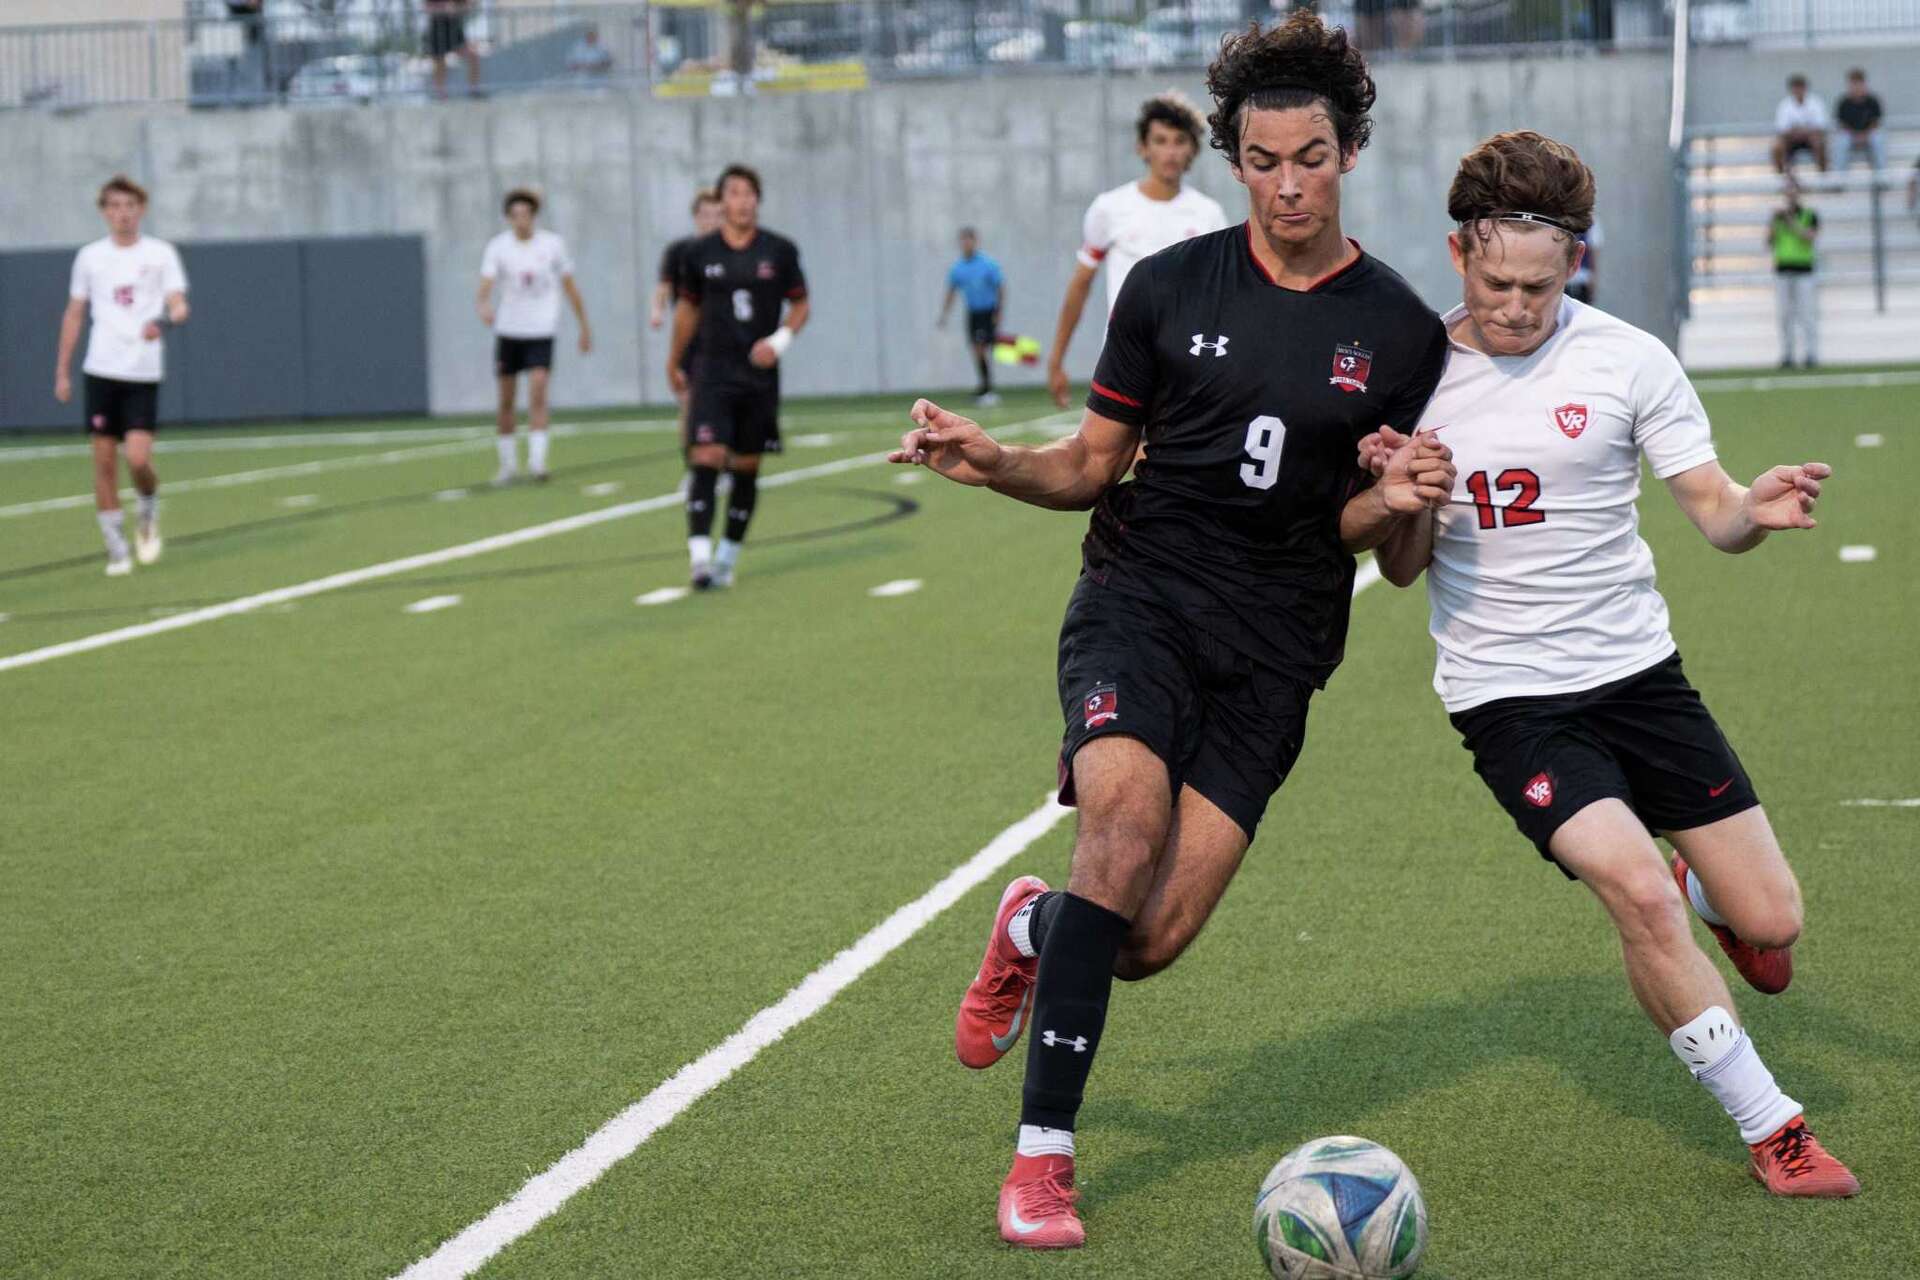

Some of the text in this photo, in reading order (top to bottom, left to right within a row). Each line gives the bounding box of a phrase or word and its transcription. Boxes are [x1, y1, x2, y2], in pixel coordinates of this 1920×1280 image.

[1556, 410, 1586, 430] VR
[1240, 415, 1286, 490] 9
[1465, 468, 1546, 529] 12
[1526, 781, 1551, 803] VR
